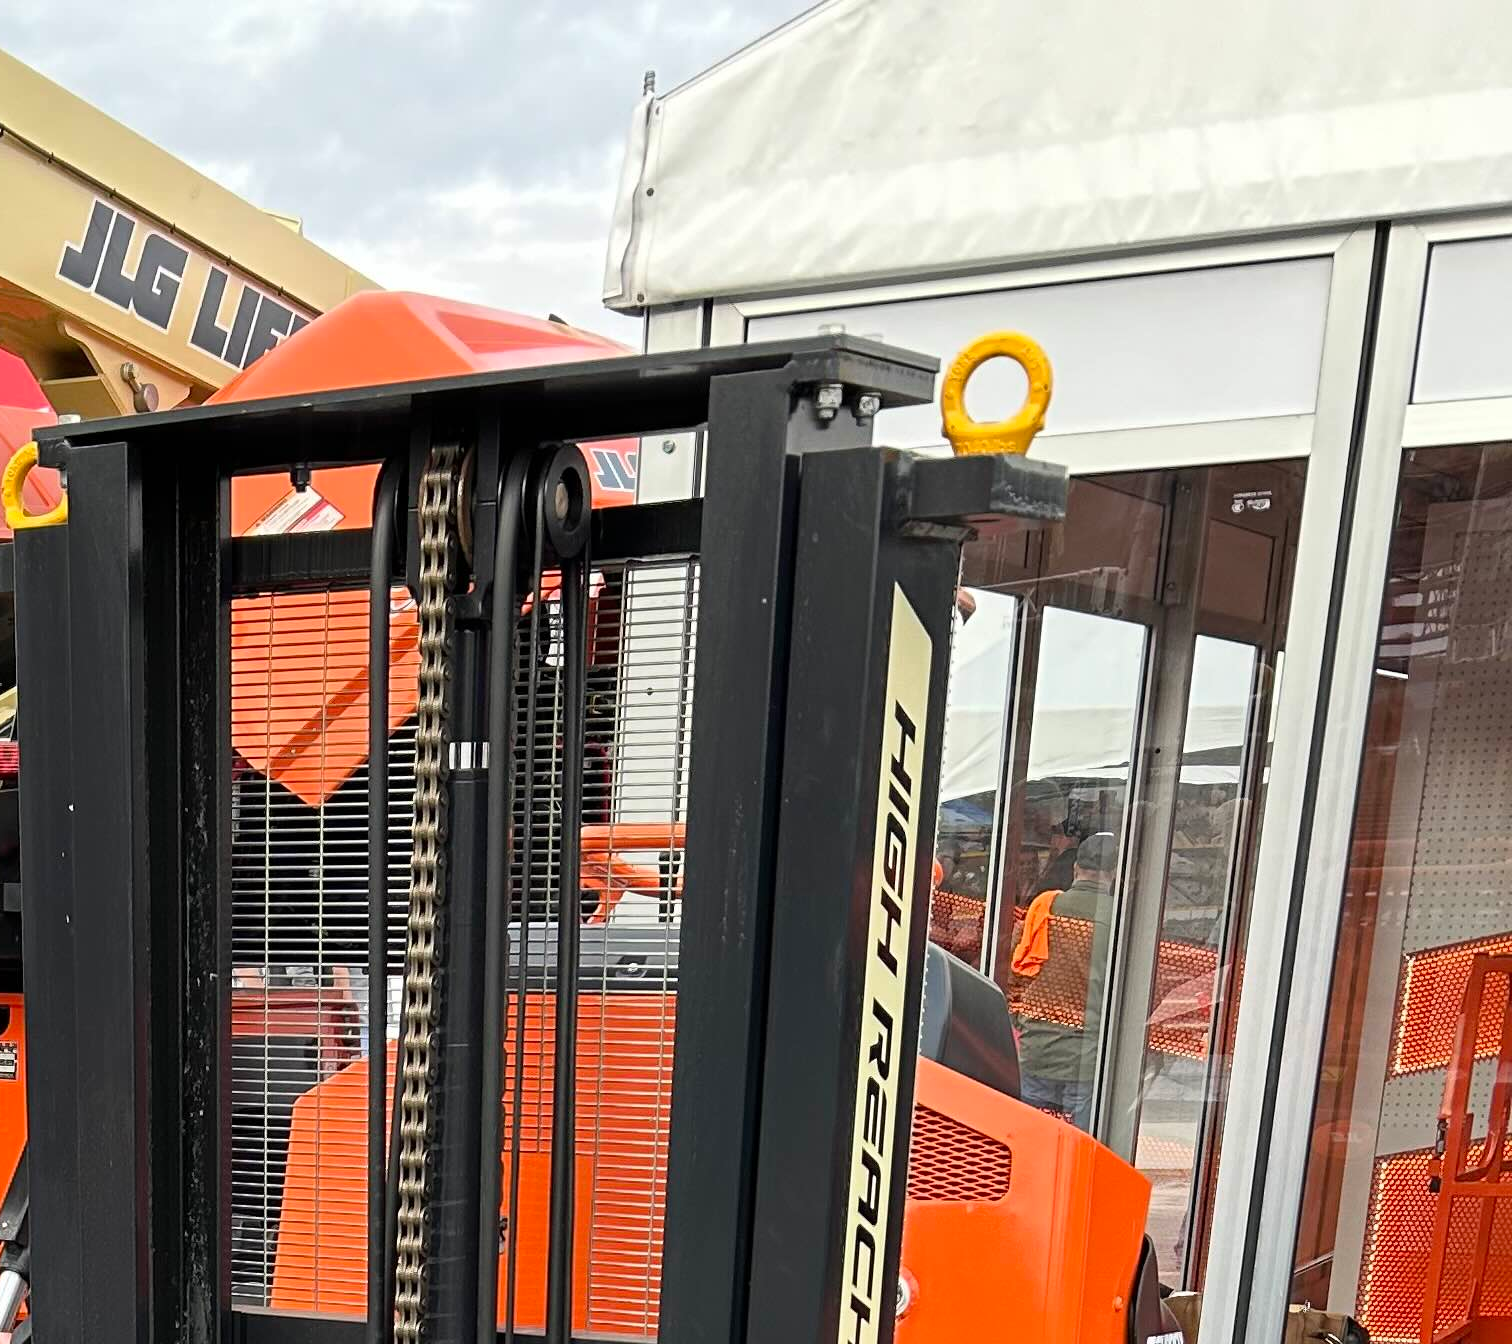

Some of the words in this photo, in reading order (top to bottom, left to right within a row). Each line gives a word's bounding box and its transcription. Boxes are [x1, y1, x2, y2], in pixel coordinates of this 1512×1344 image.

[56, 198, 190, 335] JLG
[188, 262, 311, 372] LIF
[876, 699, 918, 978] HIGH
